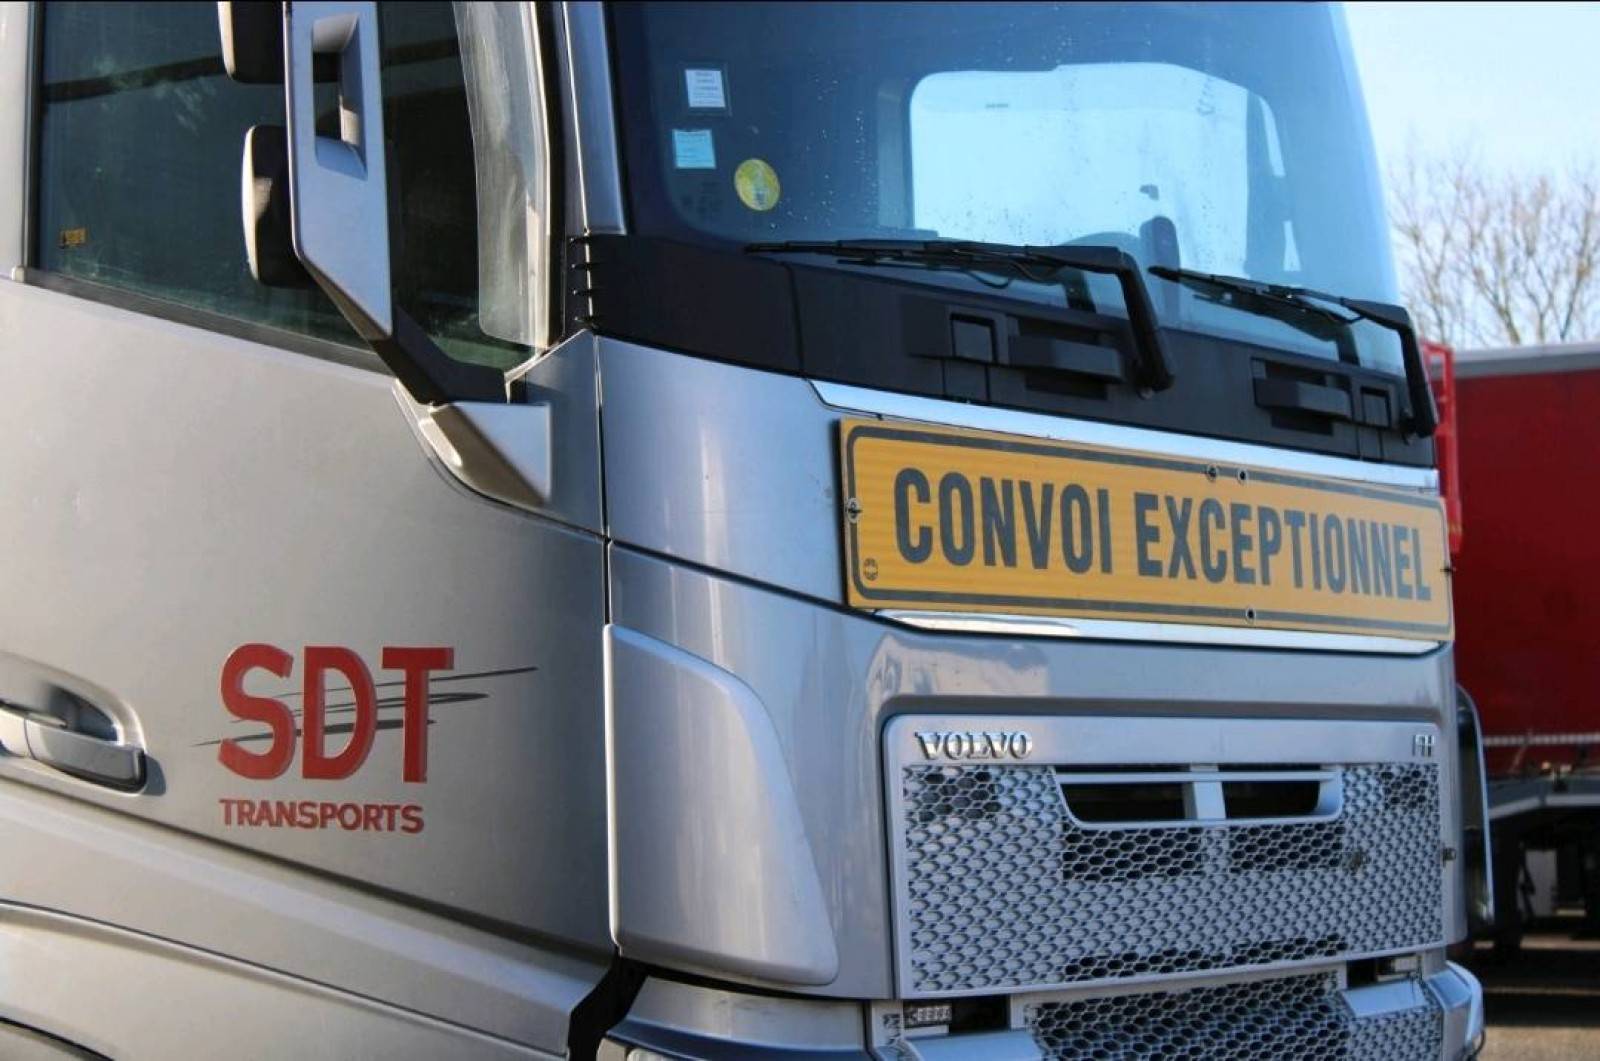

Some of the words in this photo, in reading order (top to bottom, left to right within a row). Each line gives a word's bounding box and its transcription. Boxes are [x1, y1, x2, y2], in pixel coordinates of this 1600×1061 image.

[894, 467, 1112, 574] CONVOI
[1133, 492, 1431, 601] EXCEPTIONNEL
[217, 643, 454, 783] SDT
[914, 731, 1032, 760] VOLVO
[218, 798, 424, 834] TRANSPORTS
